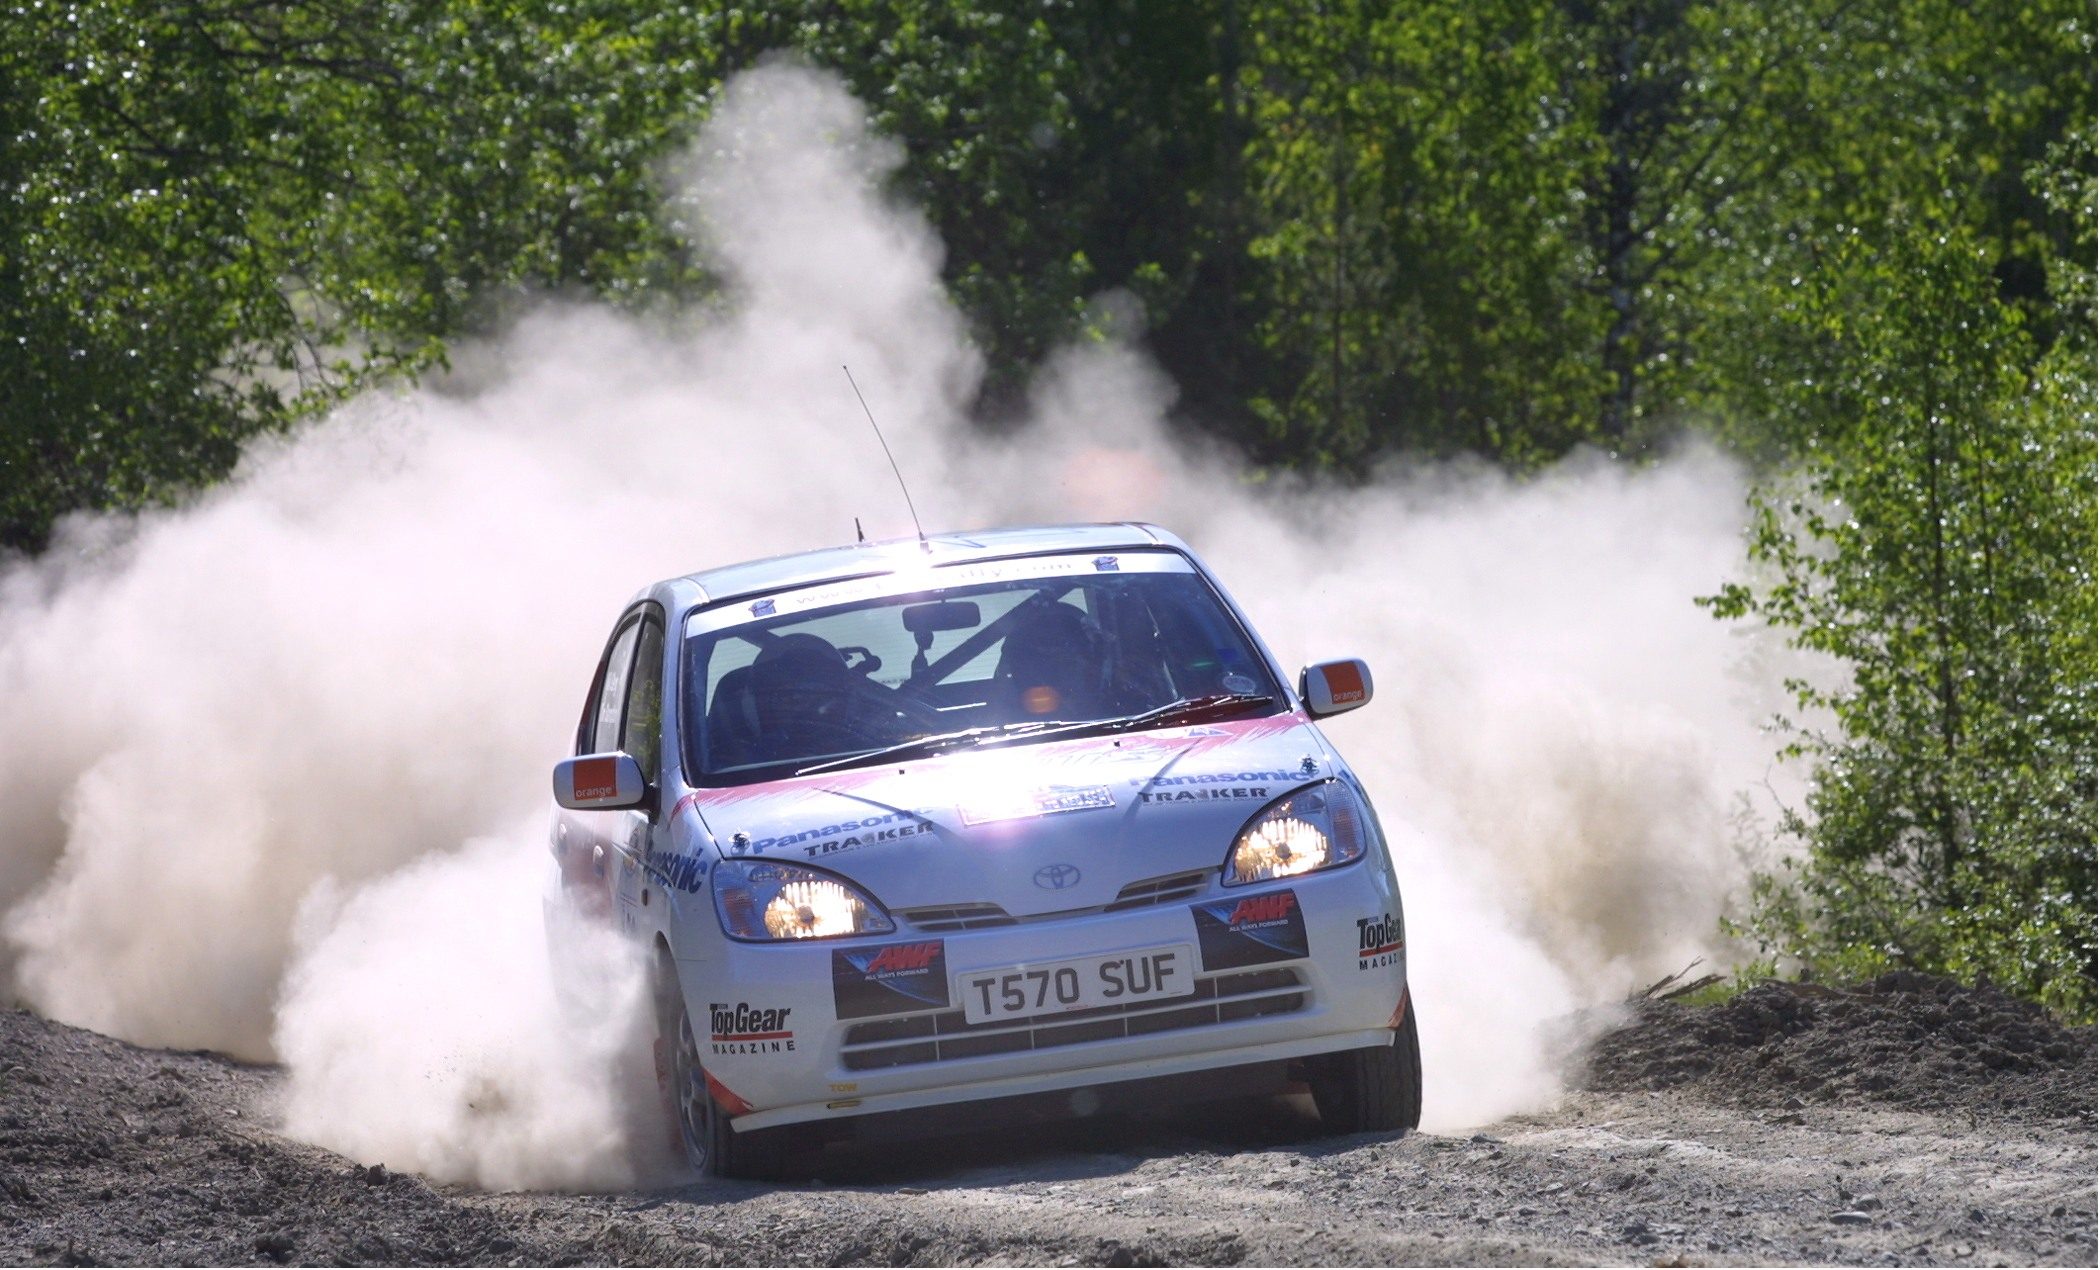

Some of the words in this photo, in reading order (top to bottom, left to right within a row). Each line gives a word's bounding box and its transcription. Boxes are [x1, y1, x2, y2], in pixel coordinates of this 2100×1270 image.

[1129, 768, 1314, 786] Panasonic
[575, 786, 612, 798] orange
[972, 967, 1080, 1016] T570
[1099, 953, 1175, 998] SUF
[709, 1002, 791, 1040] TopGear
[712, 1040, 795, 1054] MAGAZINE
[829, 1083, 858, 1092] TOW
